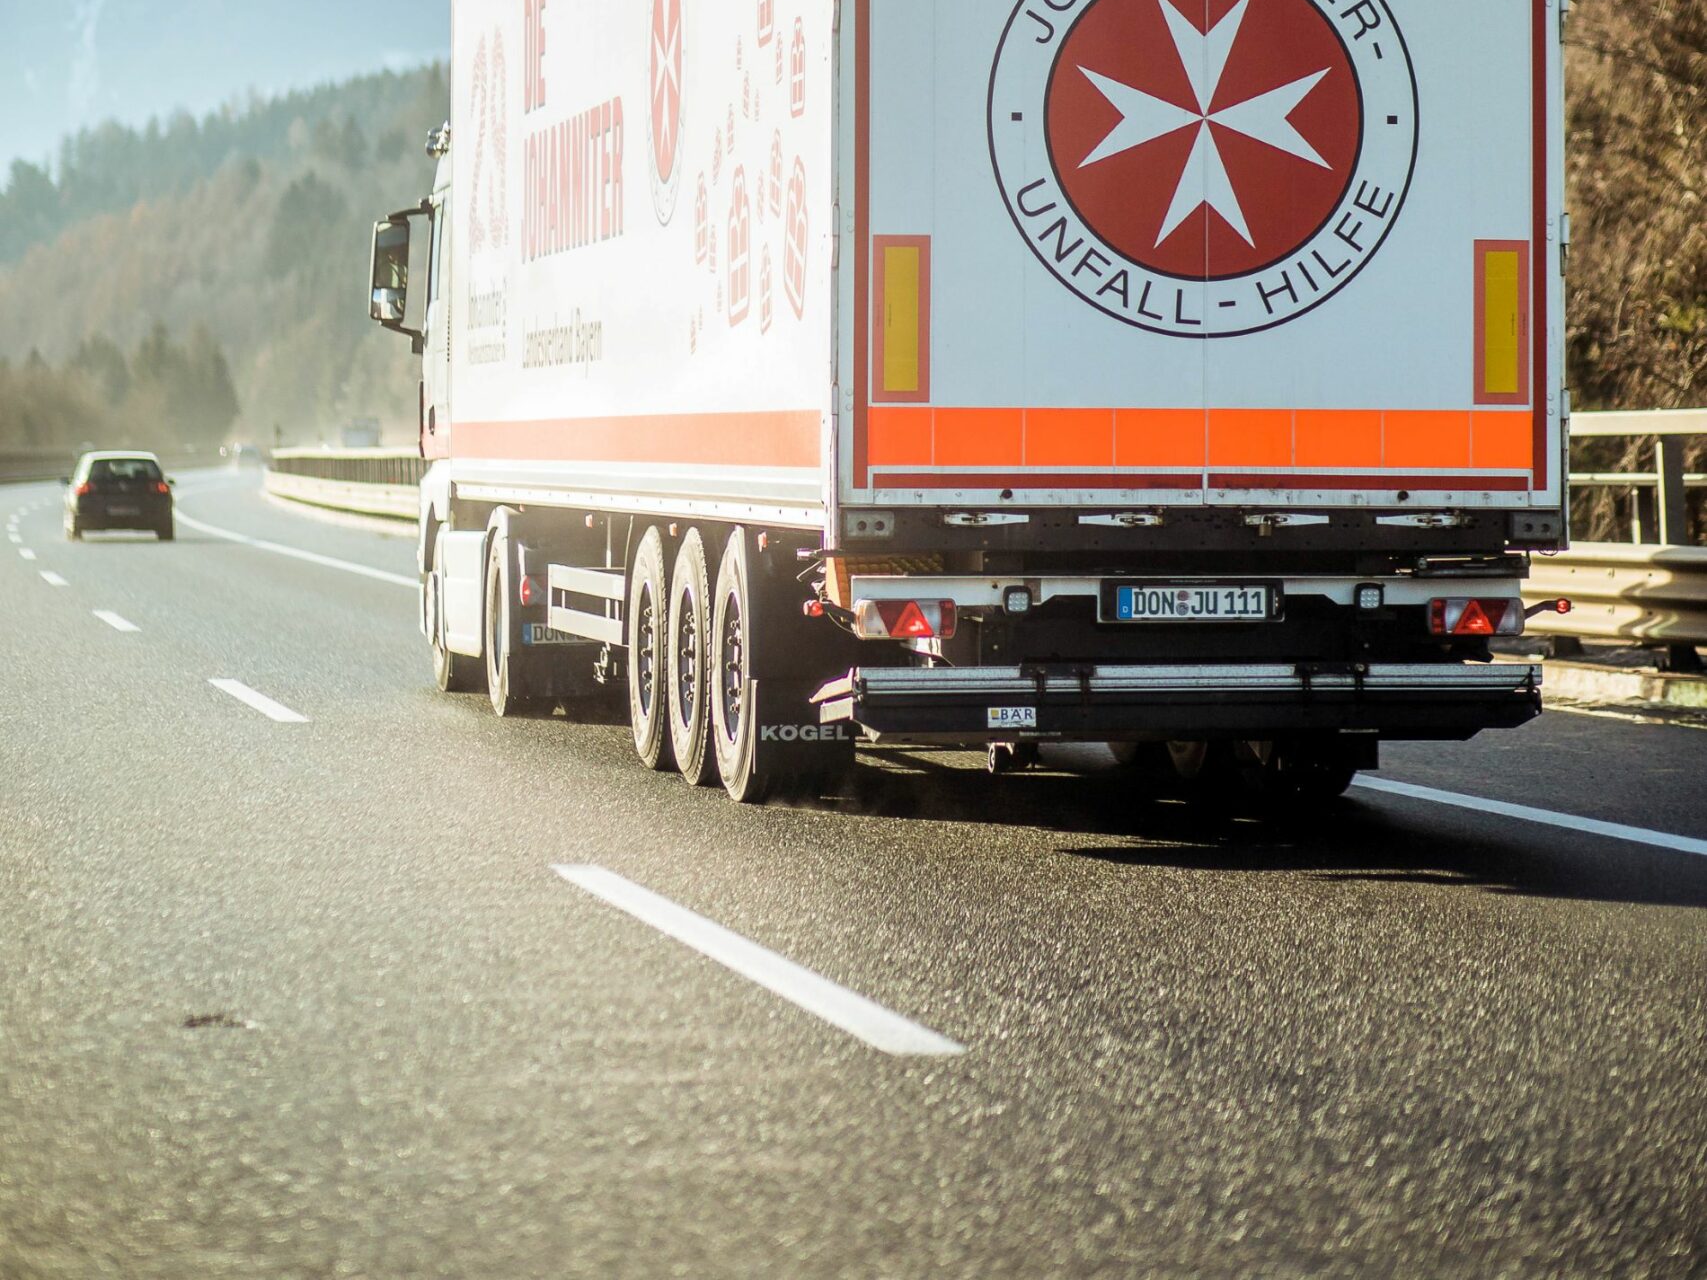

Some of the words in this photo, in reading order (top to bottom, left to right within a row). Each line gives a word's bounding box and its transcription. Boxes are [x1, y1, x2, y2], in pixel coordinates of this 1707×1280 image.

[521, 96, 623, 265] JOHANNITER
[1133, 591, 1175, 615] DON
[1191, 591, 1218, 615] JU
[1224, 591, 1263, 615] 111
[1001, 708, 1033, 720] BÄR
[761, 723, 849, 742] KÖGEL
